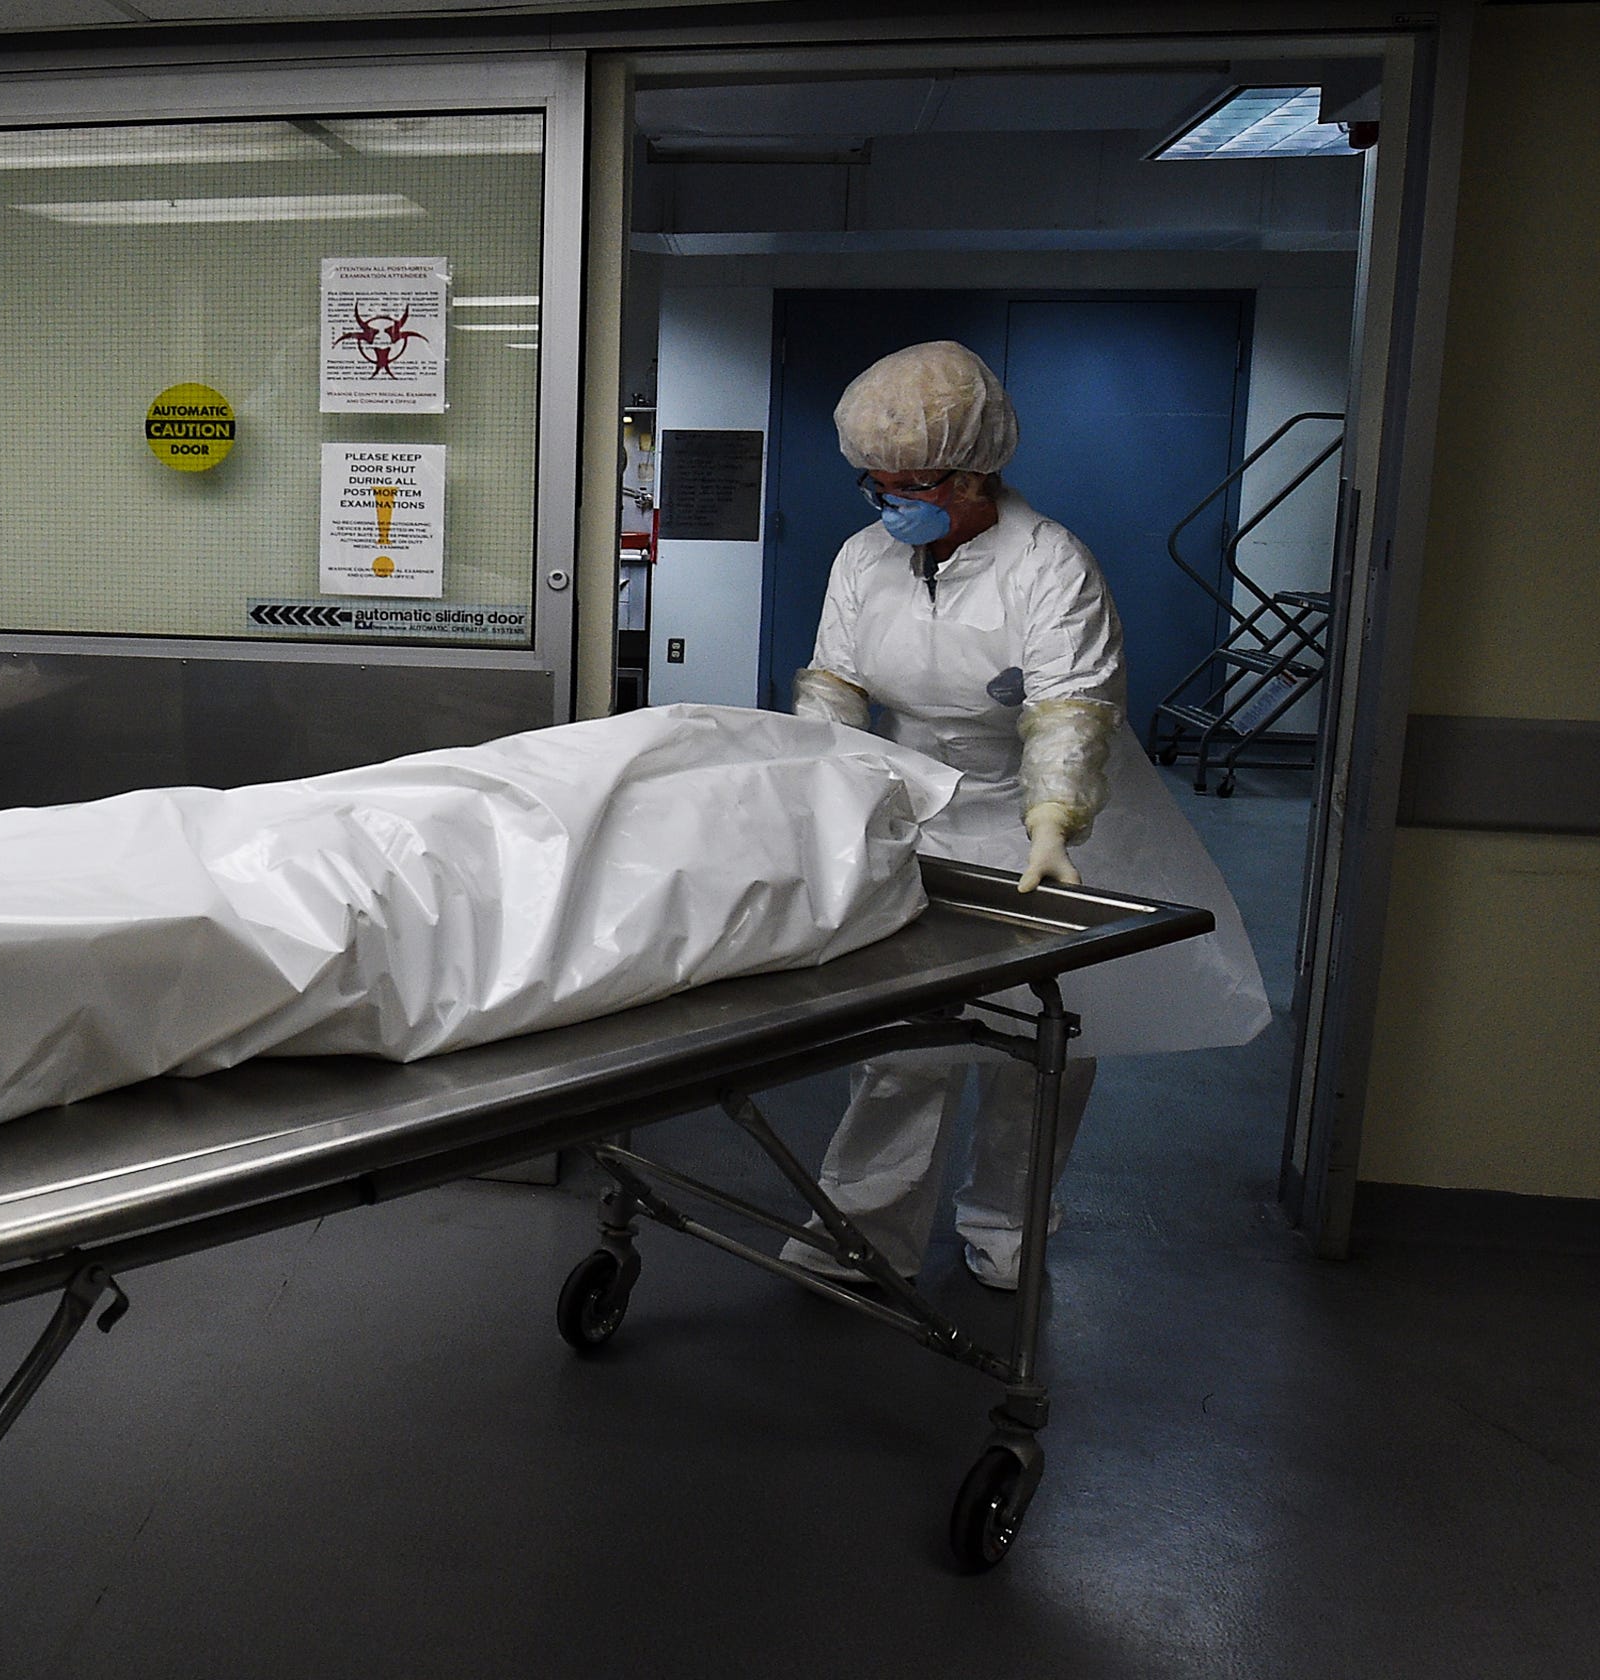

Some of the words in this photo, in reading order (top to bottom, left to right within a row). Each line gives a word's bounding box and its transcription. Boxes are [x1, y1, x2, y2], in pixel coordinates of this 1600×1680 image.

[152, 406, 228, 416] AUTOMATIC
[150, 423, 230, 437] CAUTION
[170, 444, 209, 455] DOOR
[345, 453, 389, 462] PLEASE
[391, 453, 422, 462] KEEP
[350, 464, 384, 473] DOOR
[386, 465, 416, 474] SHUT
[348, 476, 393, 485] DURING
[395, 477, 417, 485] ALL
[343, 488, 422, 497] POSTMORTEM
[340, 500, 425, 510] EXAMINATIONS
[355, 608, 432, 622] automatic
[435, 610, 484, 626] sliding
[487, 611, 525, 625] door
[492, 627, 525, 635] SYSTEMS
